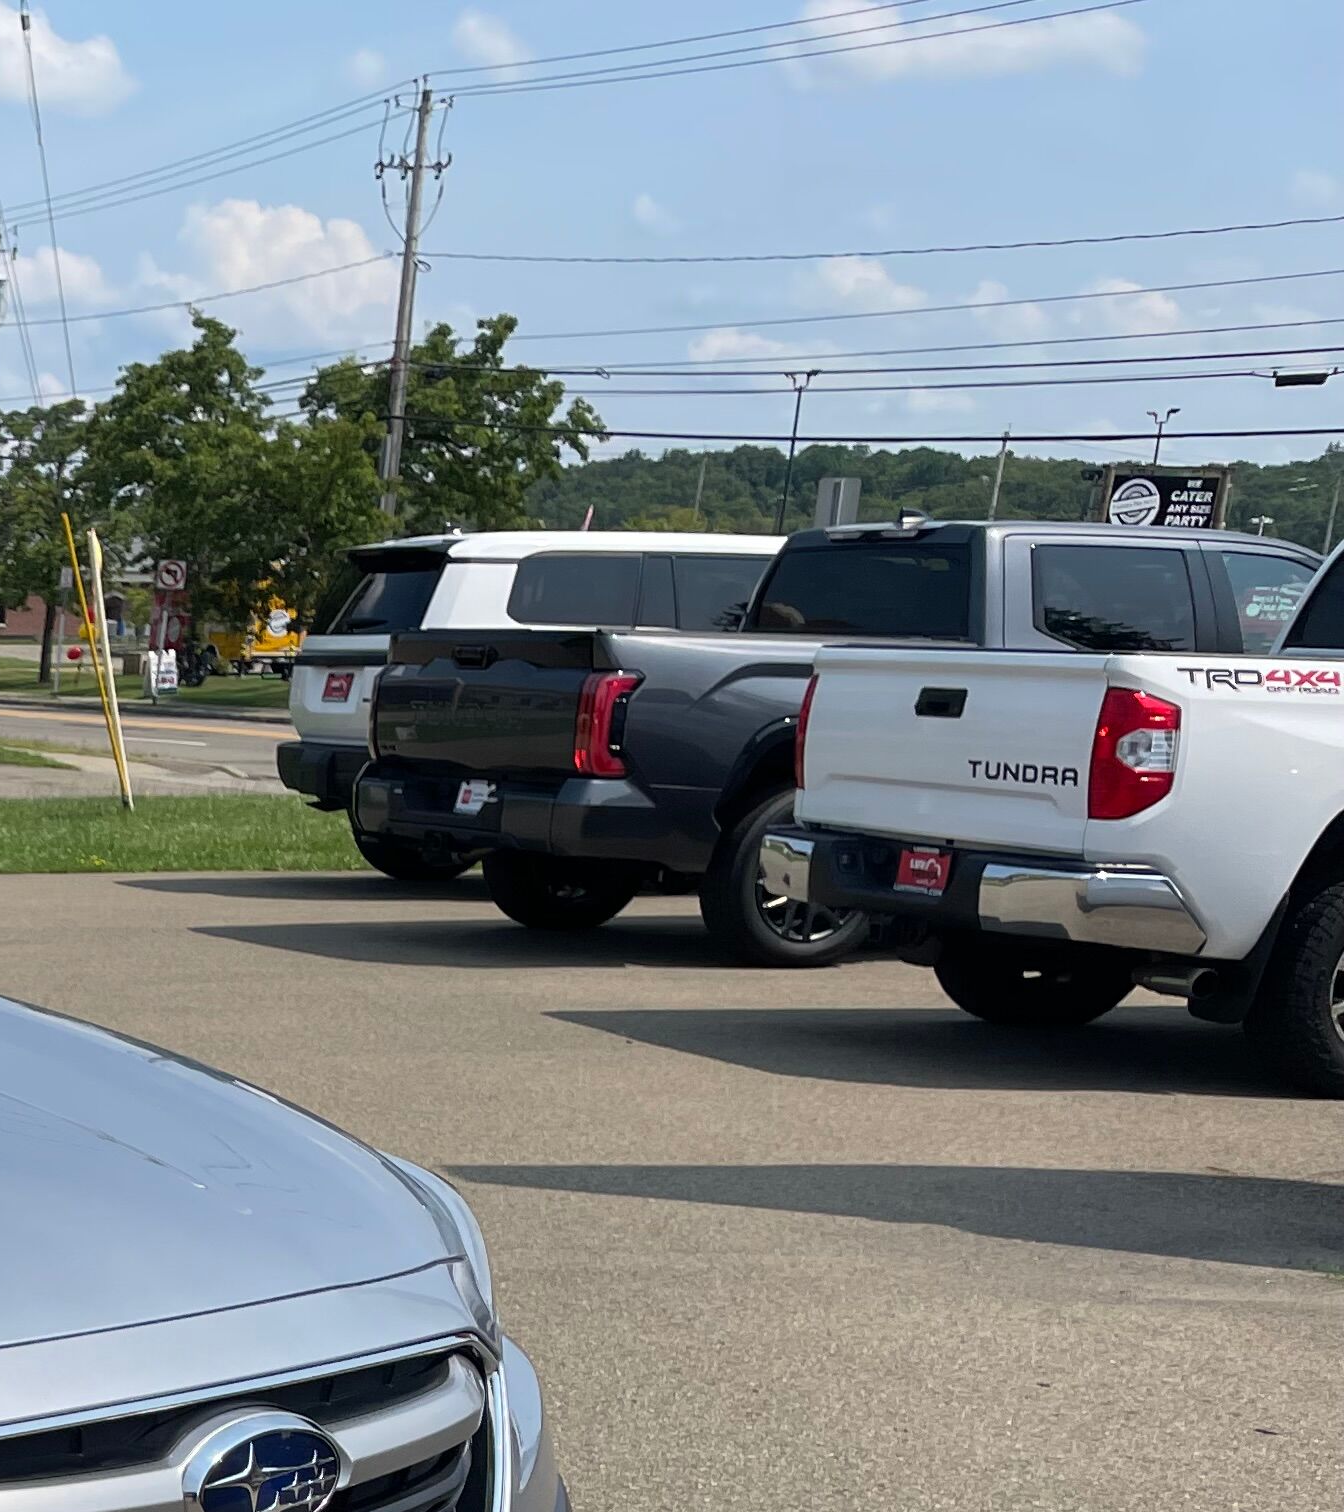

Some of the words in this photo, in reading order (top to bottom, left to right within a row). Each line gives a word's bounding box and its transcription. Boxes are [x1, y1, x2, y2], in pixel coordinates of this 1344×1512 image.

[1171, 490, 1213, 503] CATER
[1166, 504, 1188, 514] ANY
[1164, 515, 1207, 527] PARTY
[1177, 667, 1263, 691] TRD
[1299, 686, 1341, 695] ROAD
[968, 760, 1079, 786] TUNDRA
